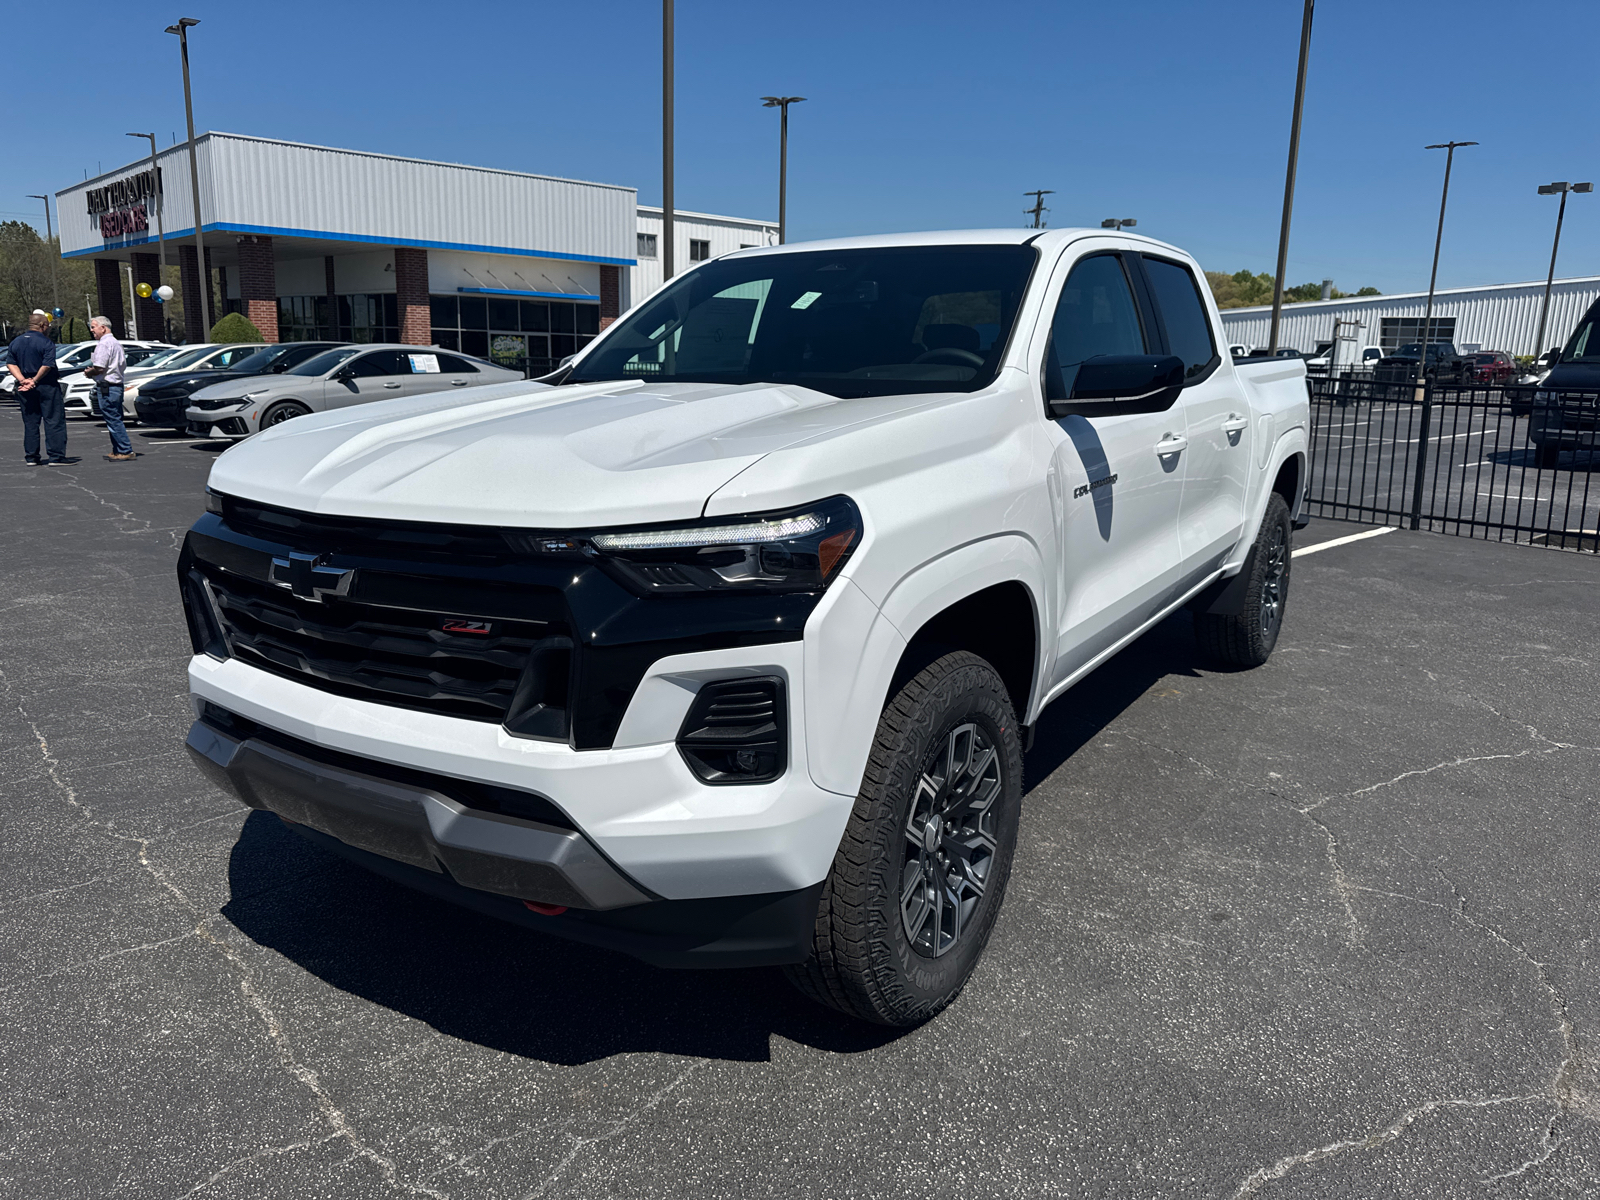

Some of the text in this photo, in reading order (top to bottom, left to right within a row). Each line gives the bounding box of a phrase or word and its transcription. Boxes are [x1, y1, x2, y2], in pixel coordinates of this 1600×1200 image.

[86, 187, 109, 214] JOHN
[101, 204, 149, 238] USED CARS
